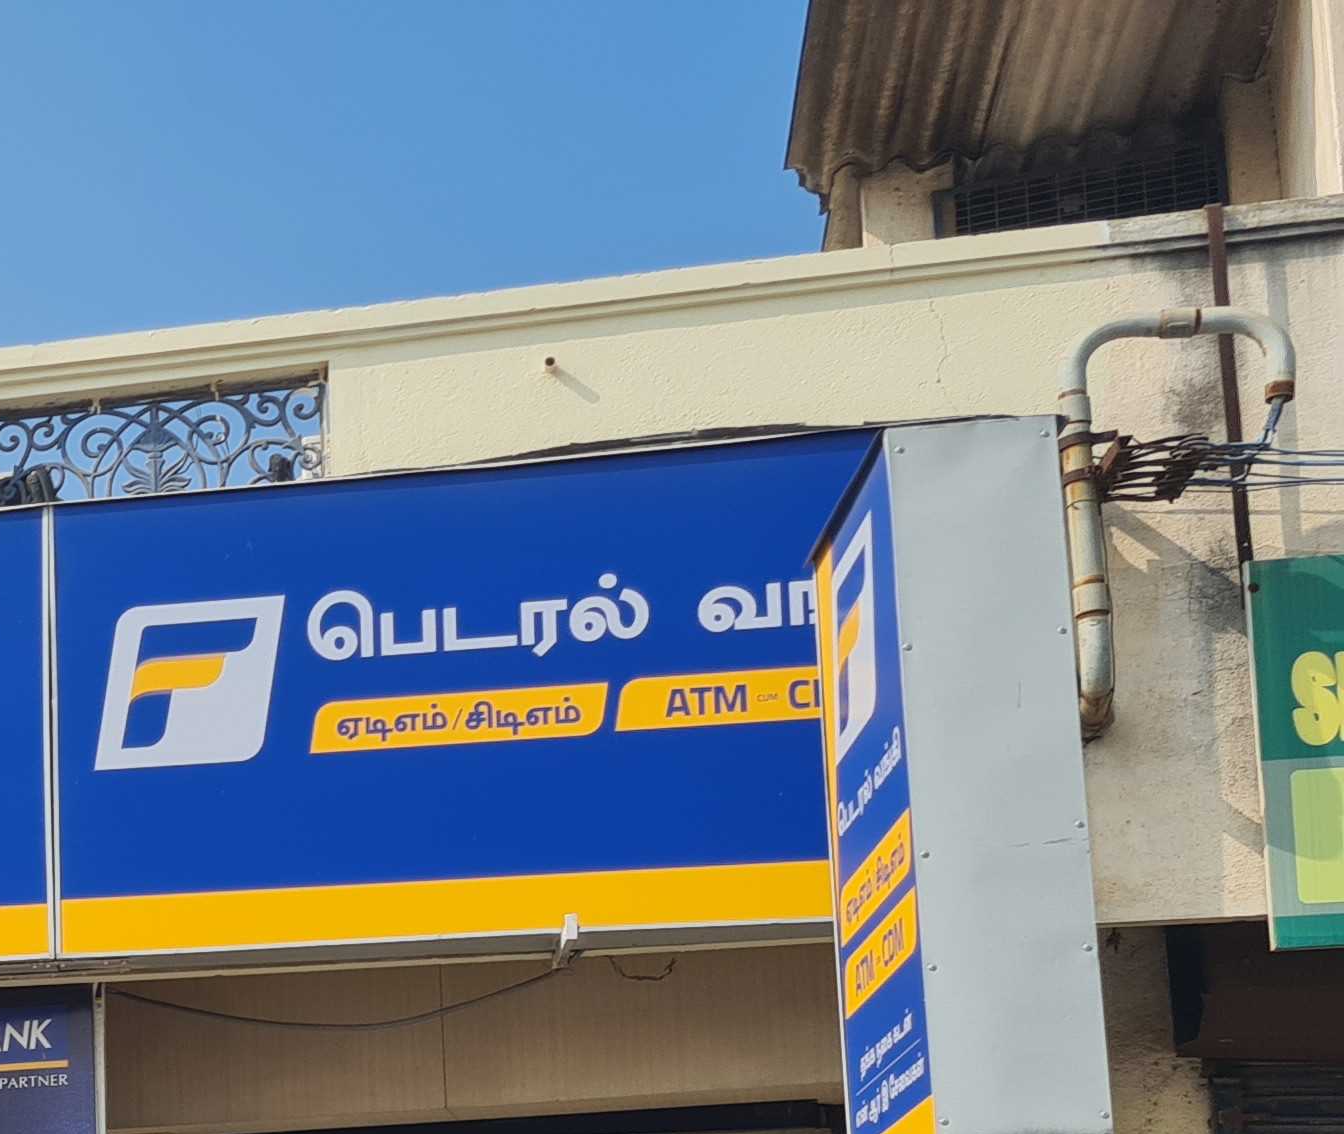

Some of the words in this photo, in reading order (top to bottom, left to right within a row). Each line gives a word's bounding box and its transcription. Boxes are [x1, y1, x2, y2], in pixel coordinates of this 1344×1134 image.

[307, 573, 649, 661] பெடரல்
[666, 684, 748, 718] ATM
[855, 949, 876, 998] ATM
[882, 917, 905, 968] CDM
